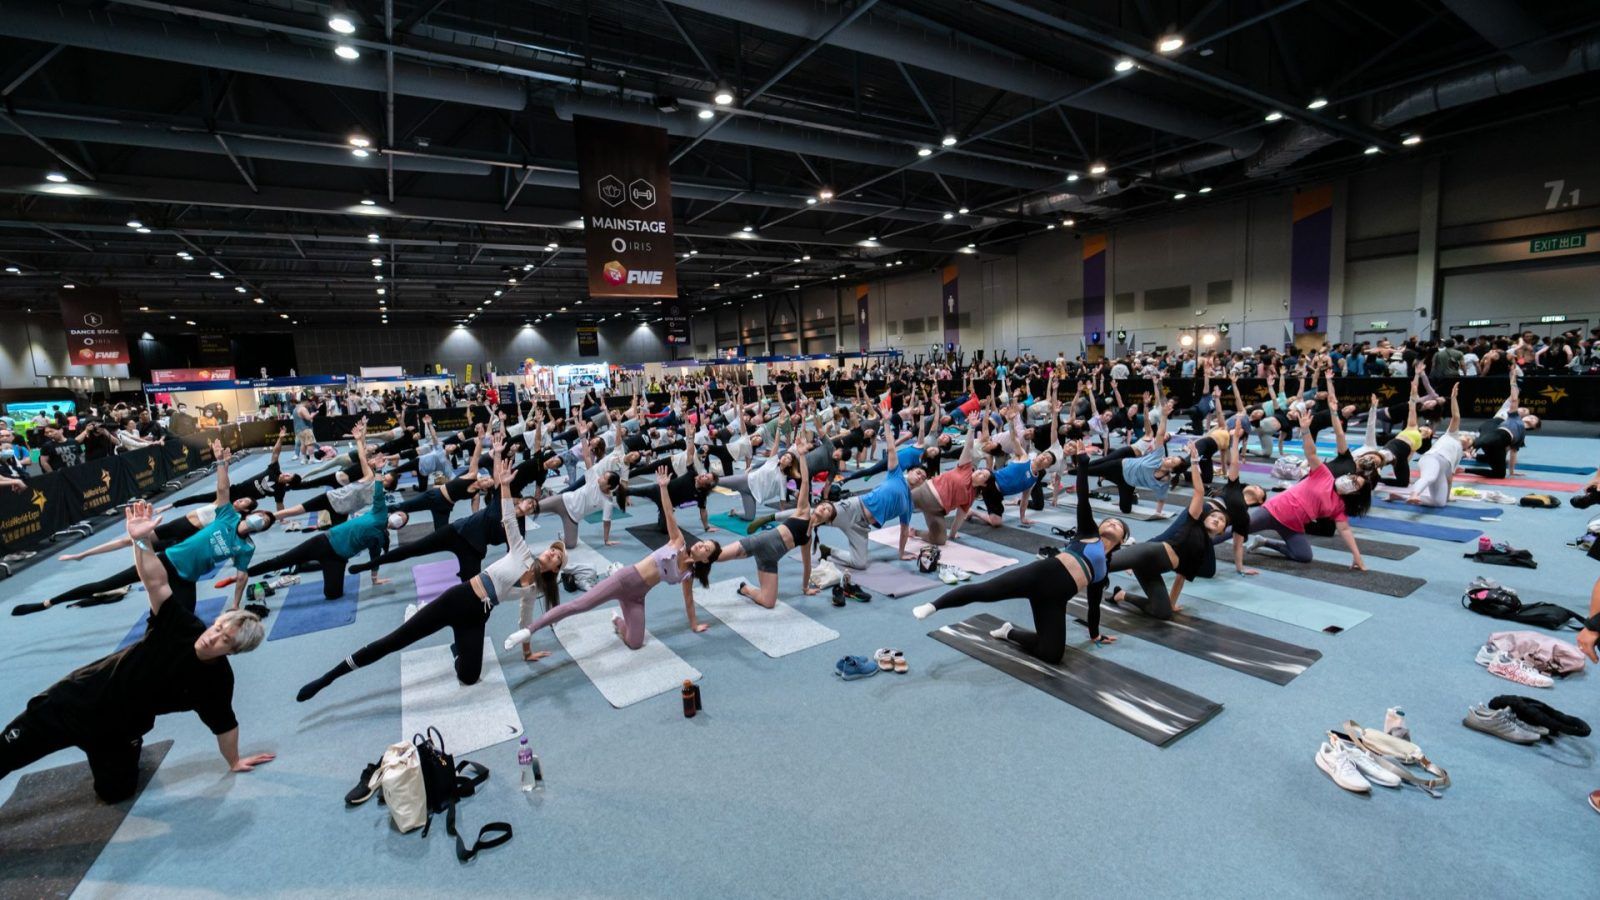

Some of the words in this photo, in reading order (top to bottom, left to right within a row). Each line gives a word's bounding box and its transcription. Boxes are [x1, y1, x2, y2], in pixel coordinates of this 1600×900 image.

[1544, 179, 1580, 210] 7.1
[592, 216, 666, 233] MAINSTAGE
[629, 240, 652, 252] IRIS
[1534, 238, 1558, 252] EXIT
[1559, 236, 1582, 249] 出口
[627, 269, 664, 285] FWE
[95, 351, 120, 359] FWE
